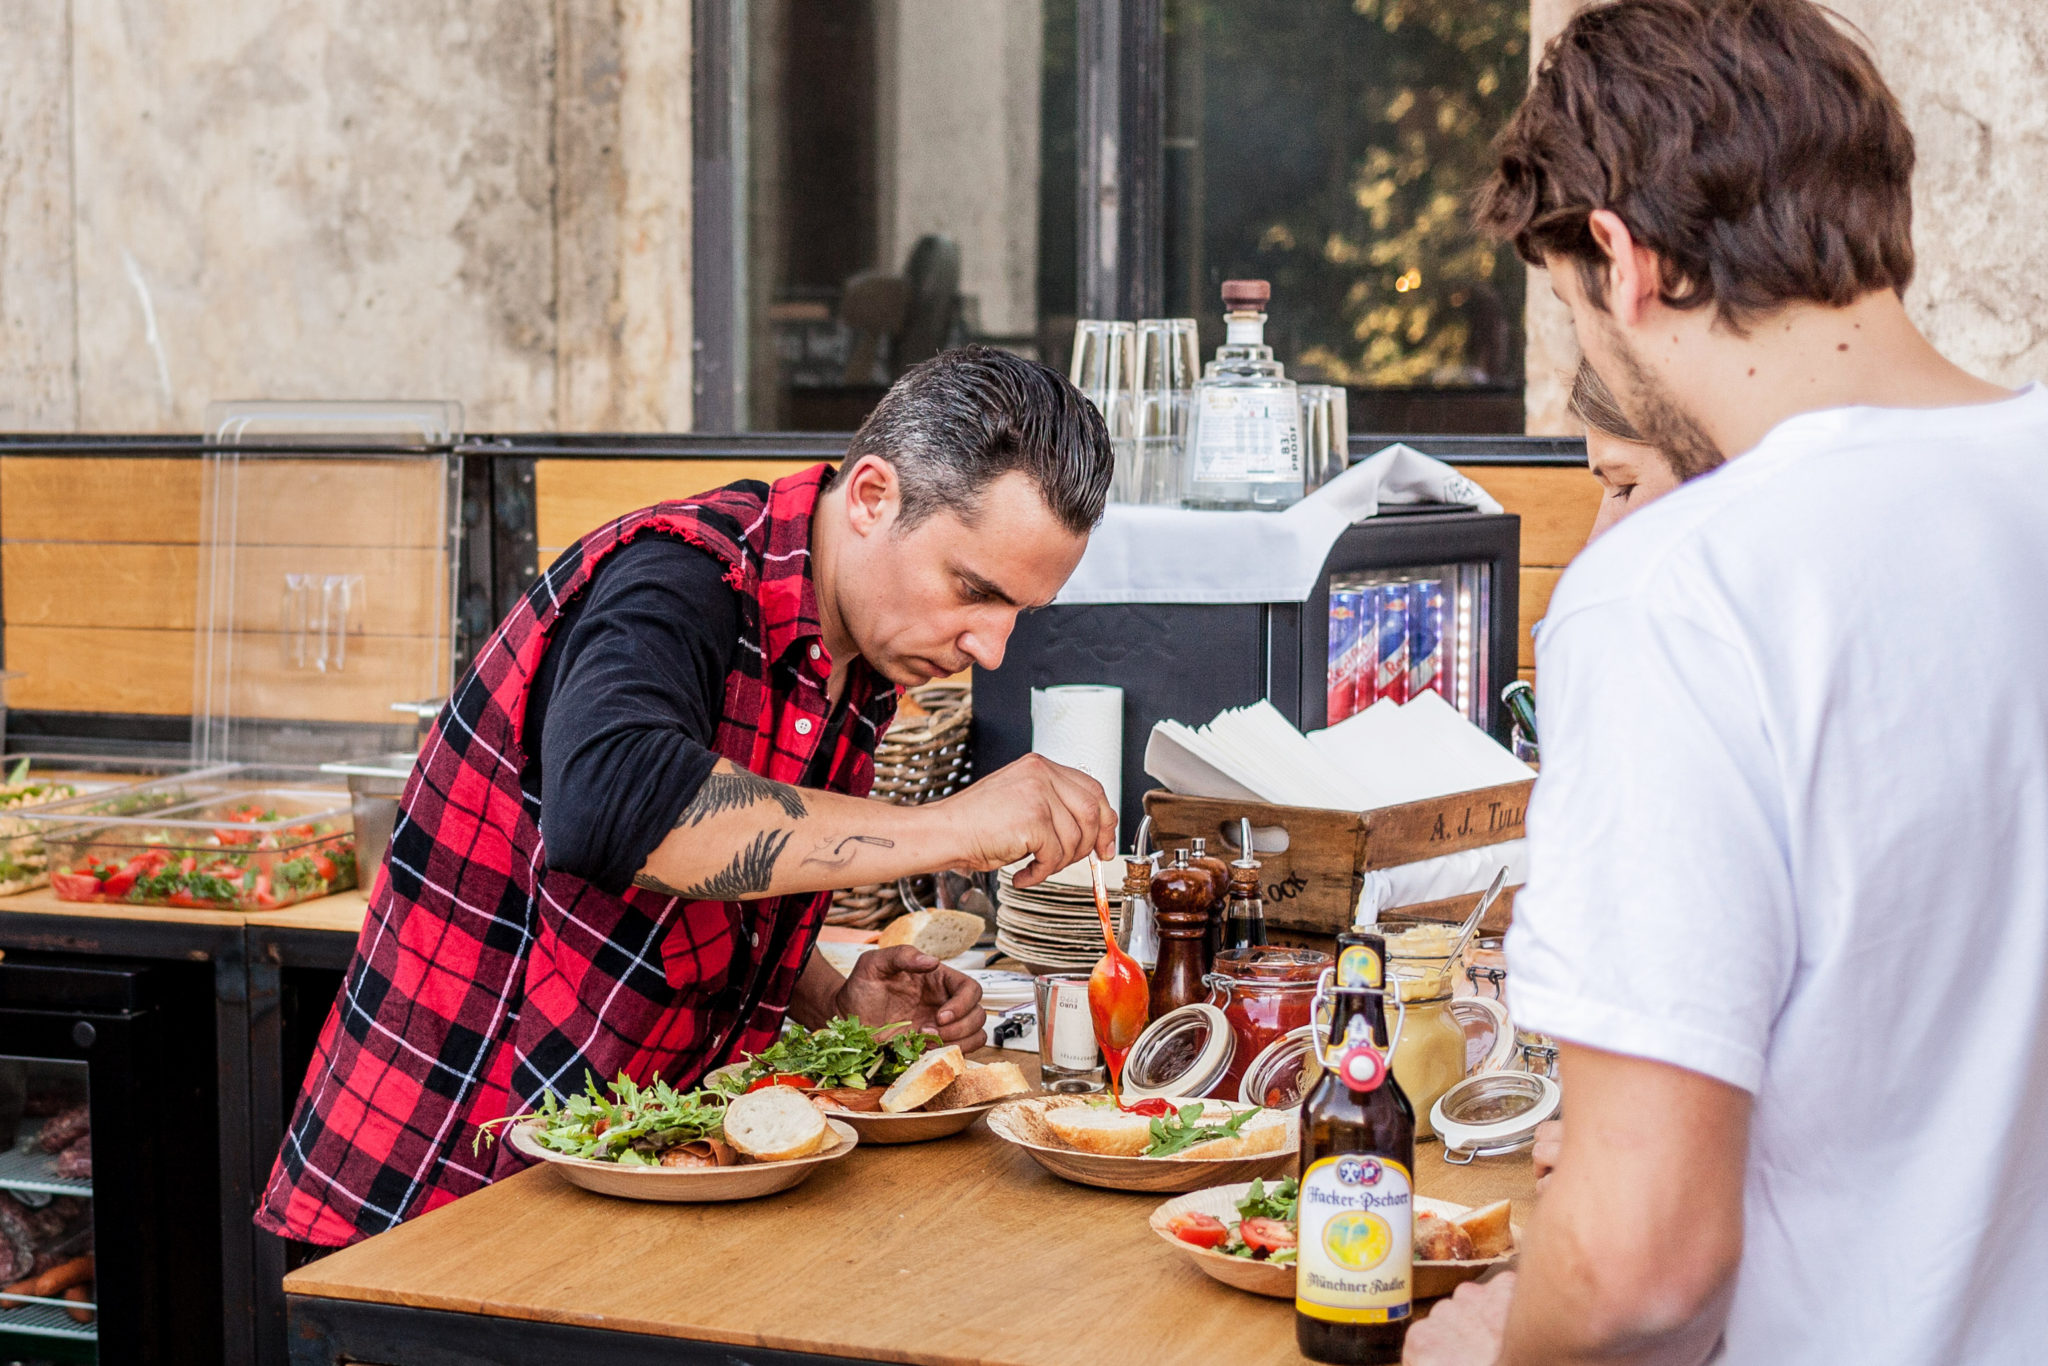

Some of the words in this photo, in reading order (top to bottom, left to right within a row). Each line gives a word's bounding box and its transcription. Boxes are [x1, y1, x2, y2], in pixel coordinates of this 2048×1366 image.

[1289, 425, 1299, 471] PROOF
[1429, 812, 1451, 841] A.
[1457, 807, 1473, 836] J.
[1059, 1002, 1078, 1010] EURO
